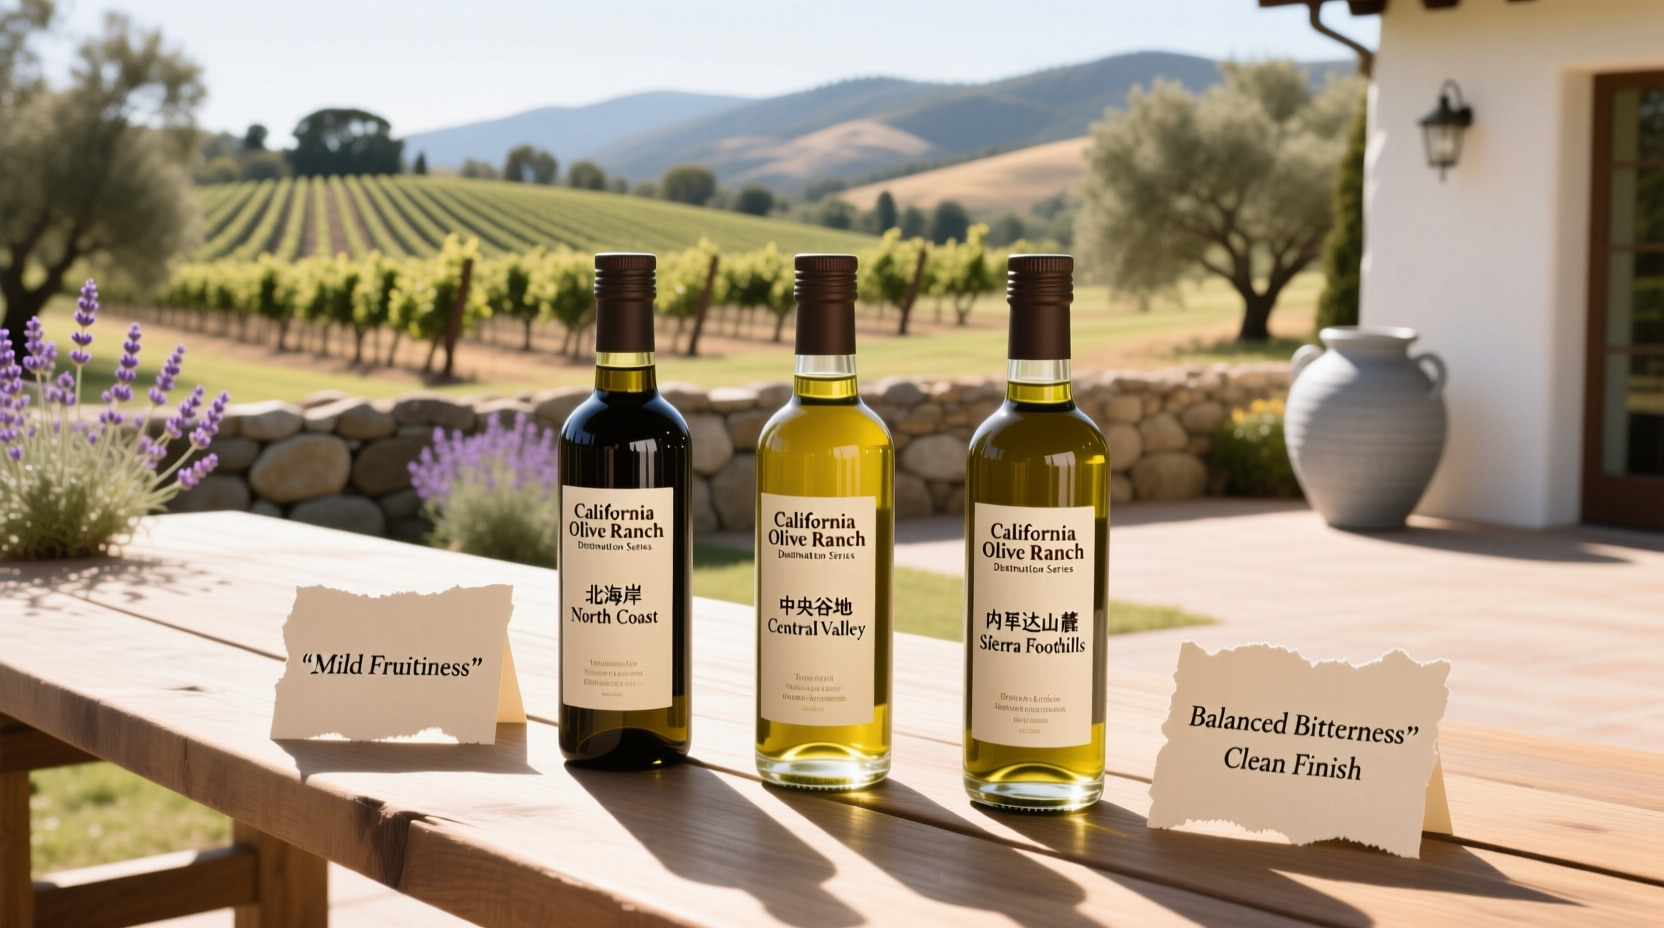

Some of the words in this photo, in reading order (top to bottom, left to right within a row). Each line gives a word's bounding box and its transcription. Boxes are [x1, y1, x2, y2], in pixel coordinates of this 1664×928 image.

[574, 502, 655, 521] California
[774, 511, 856, 529] California
[569, 520, 606, 539] Olive
[610, 522, 665, 539] Ranch
[768, 528, 808, 547] Olive
[812, 530, 866, 548] Ranch
[990, 522, 1077, 541] California
[982, 541, 1026, 560] Olive
[1030, 542, 1085, 561] Ranch
[585, 583, 643, 607] 北海岸
[570, 606, 612, 625] North
[616, 608, 659, 625] Coast
[779, 595, 854, 617] 中央谷地
[767, 617, 818, 636] Central
[821, 619, 867, 641] Valley
[979, 634, 1021, 654] Sierra
[1025, 636, 1086, 654] Foothills
[1188, 705, 1289, 735] Balanced
[1223, 746, 1286, 774] Clean
[1291, 753, 1362, 781] Finish
